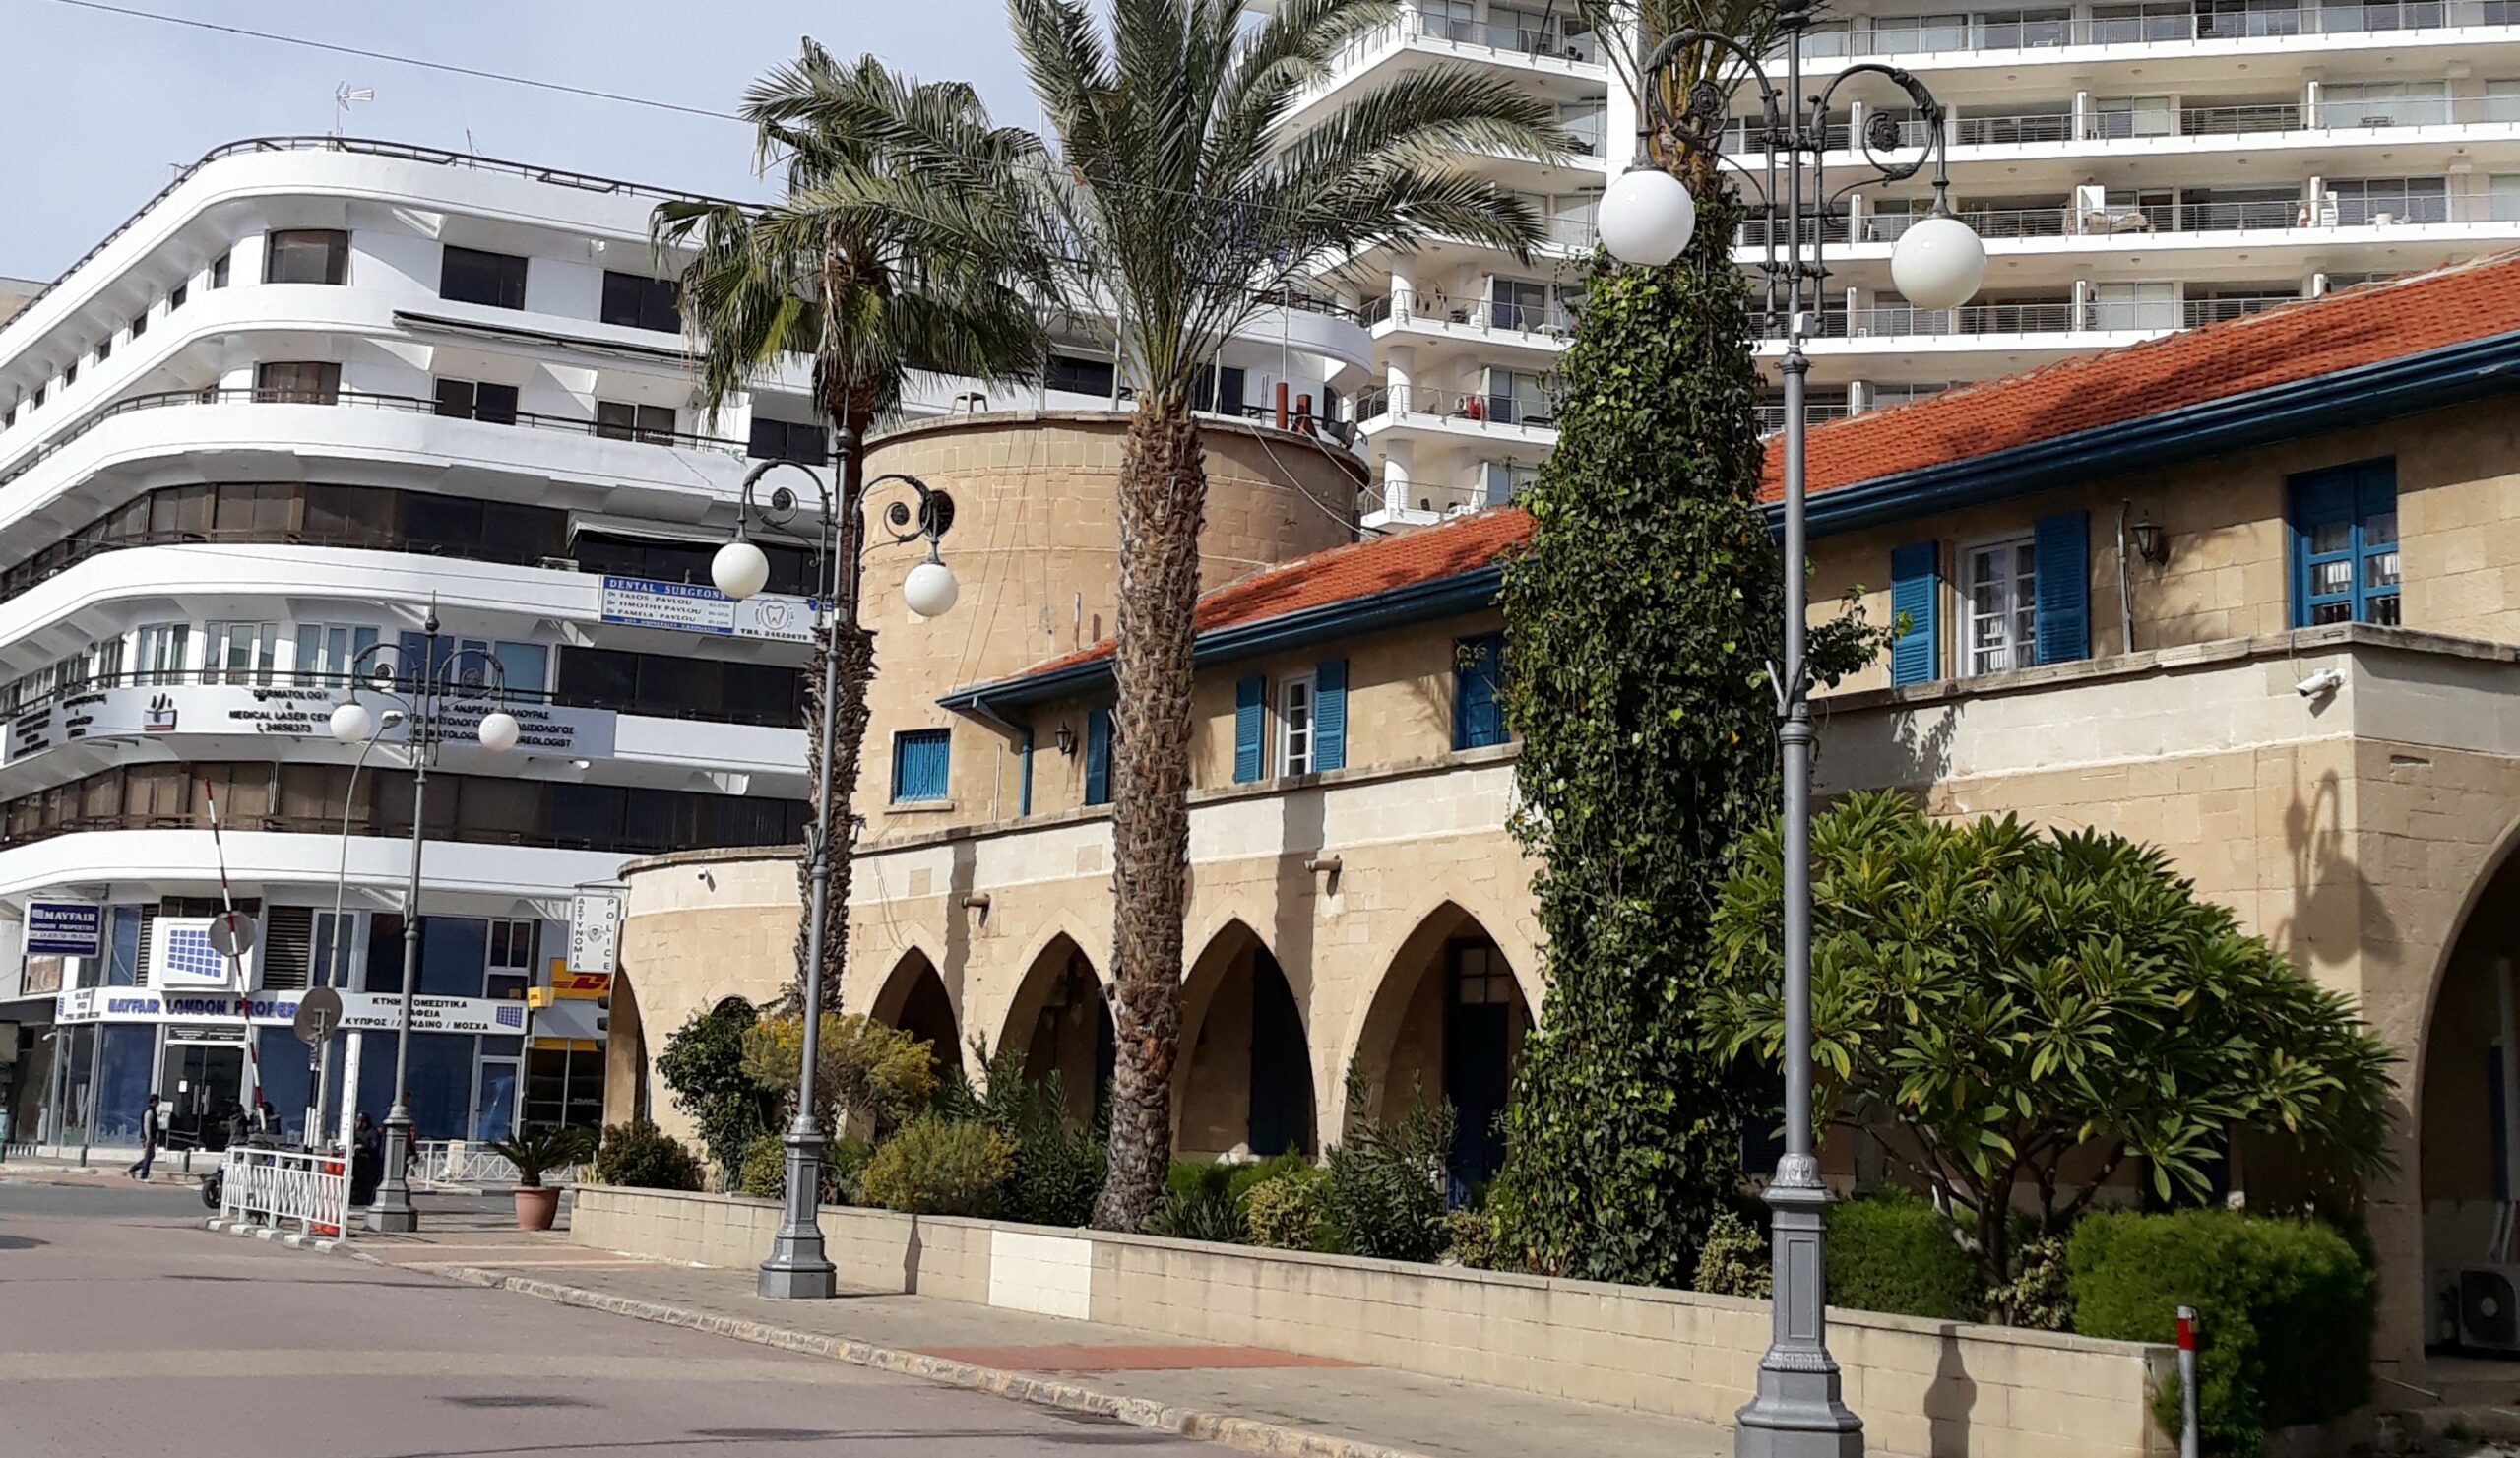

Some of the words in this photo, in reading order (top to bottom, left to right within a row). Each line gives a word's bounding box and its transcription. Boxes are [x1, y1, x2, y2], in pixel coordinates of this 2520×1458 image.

[609, 579, 656, 592] DENTAL
[664, 585, 725, 600] SURGEONS
[620, 592, 650, 601] TASOS
[655, 597, 693, 605] PAVLOU
[617, 608, 654, 618] PAMELA
[659, 612, 696, 622] PAVLOU
[619, 601, 662, 610] TIMOTHY
[664, 604, 702, 615] PAVLOU
[252, 689, 329, 701] DERMATOLOGY
[228, 710, 273, 721] MEDICAL
[275, 711, 308, 721] LASER
[310, 713, 332, 722] CEN
[44, 911, 95, 921] MAYFAIR
[573, 897, 587, 970] ΑΣΤΥΝΟΜΙΑ
[602, 898, 615, 971] POLICE
[165, 998, 227, 1016] LONDON
[233, 1000, 298, 1018] PROPER
[372, 997, 468, 1009] ΚΤΗΜΟΜΕΣΙΤΙΚΑ
[398, 1008, 441, 1018] ΑΦΕΙΑ
[345, 1017, 387, 1027] ΚΥΠΡΟΣ
[396, 1019, 442, 1029] ΝΔΙΝΟ
[453, 1022, 489, 1031] ΜΟΣΧΑ
